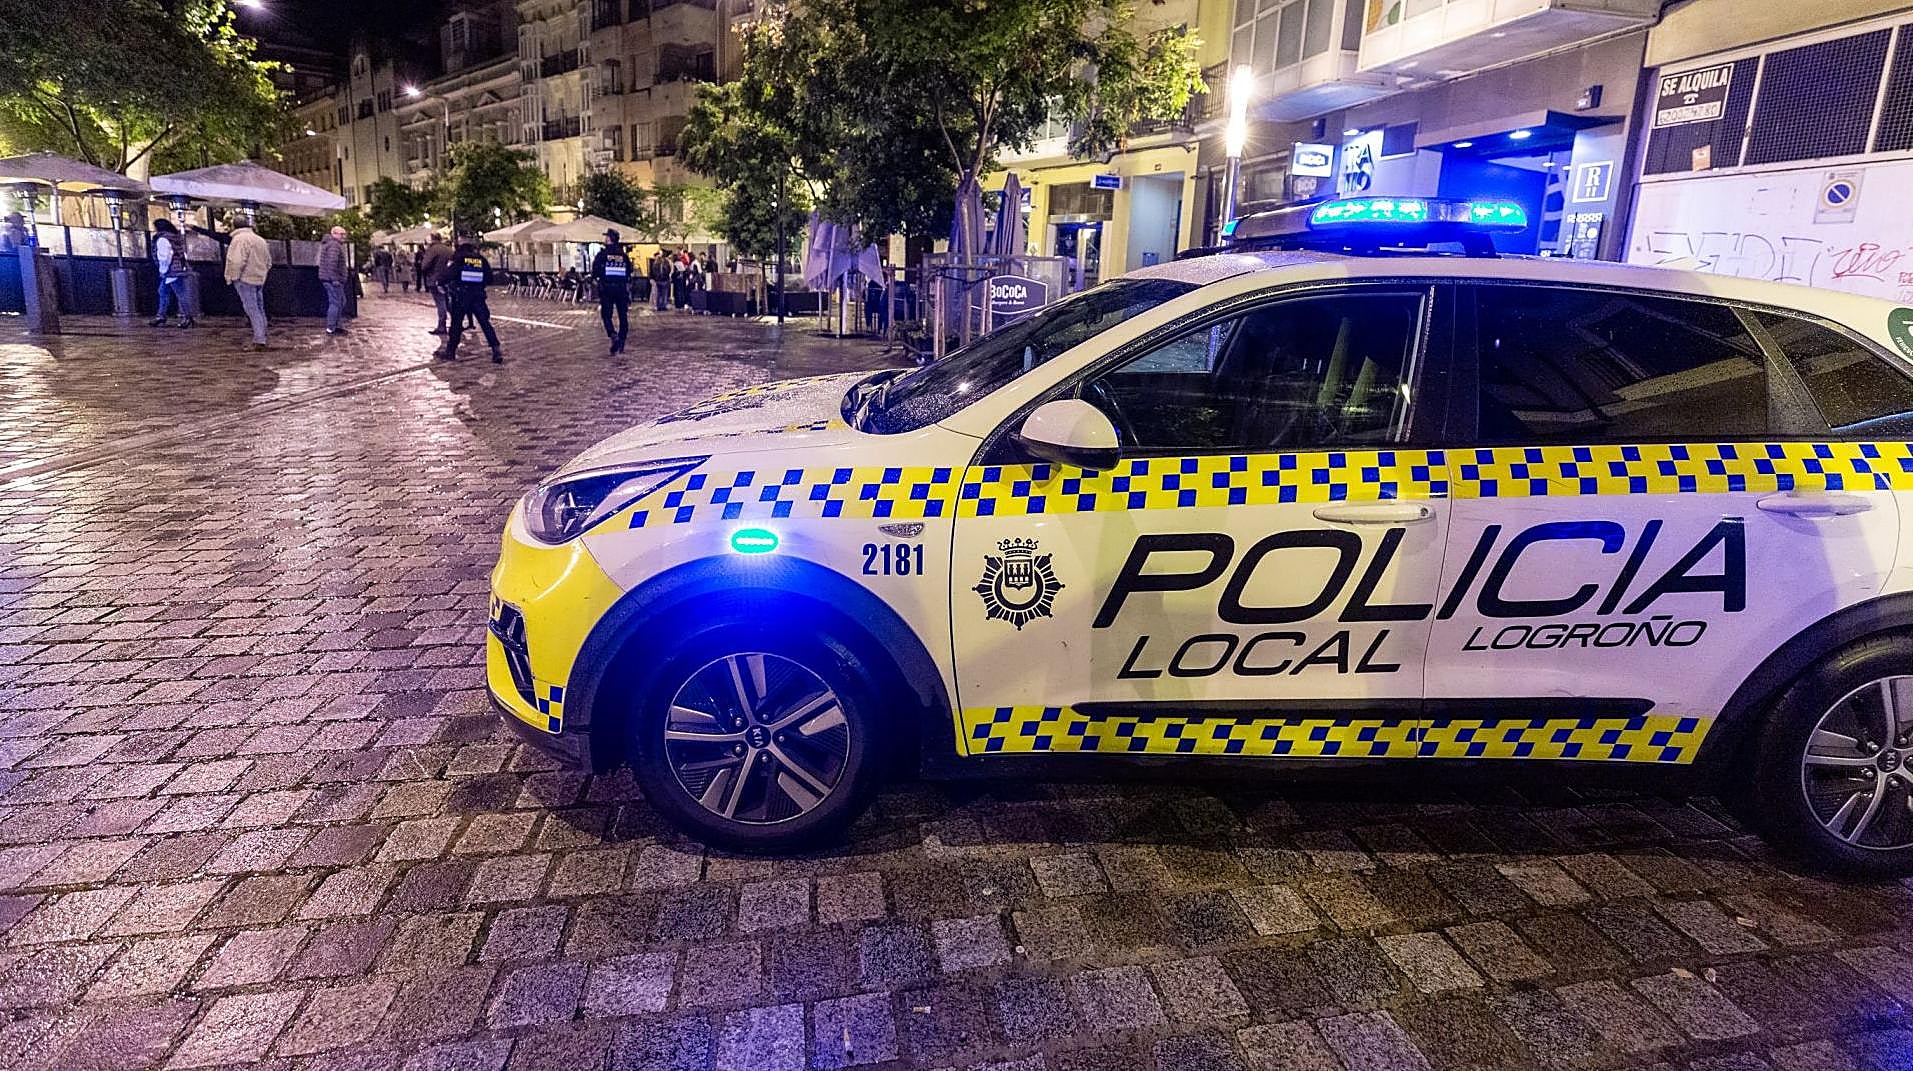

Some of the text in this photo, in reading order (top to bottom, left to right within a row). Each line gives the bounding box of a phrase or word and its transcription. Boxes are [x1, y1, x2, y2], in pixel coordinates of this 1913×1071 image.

[1661, 67, 1728, 97] SE ALQUILA
[862, 543, 924, 576] 2181
[1091, 518, 1747, 629] POLICIA
[1461, 615, 1708, 653] LOGROÑO
[1116, 629, 1402, 680] LOCAL
